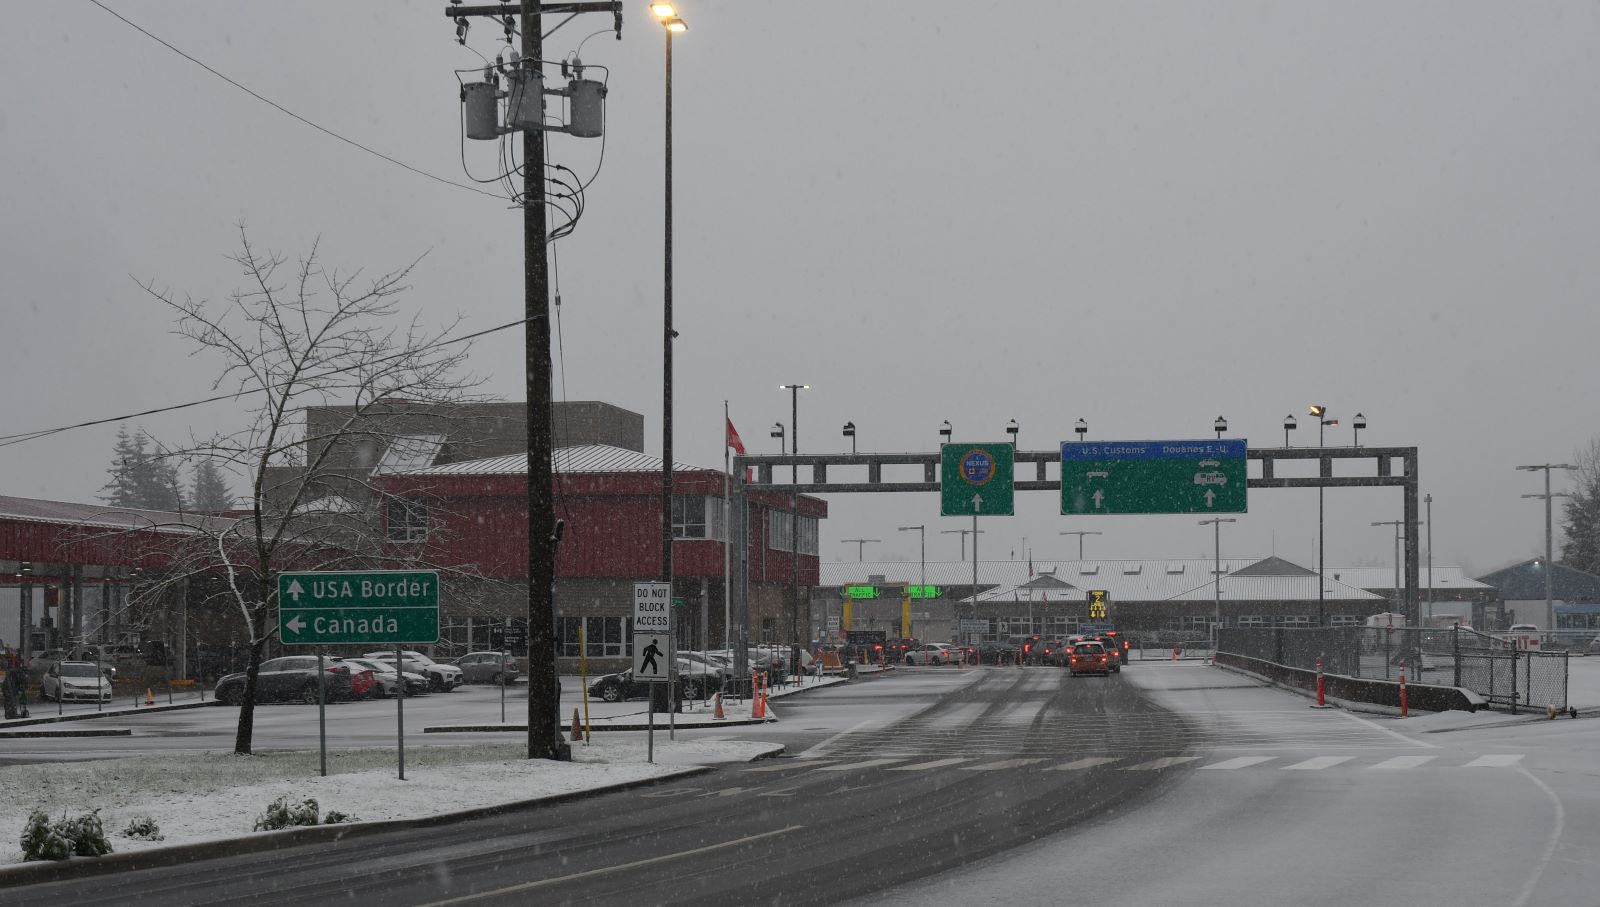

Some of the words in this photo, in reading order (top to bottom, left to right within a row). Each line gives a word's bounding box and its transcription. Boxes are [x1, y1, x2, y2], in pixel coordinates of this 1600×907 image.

[1082, 447, 1100, 455] U.S.
[1104, 446, 1146, 454] Customs
[1163, 446, 1204, 454] Douanes
[1206, 474, 1216, 482] RV
[313, 581, 353, 599] USA
[361, 579, 430, 598] Border
[637, 589, 648, 598] DO
[652, 589, 667, 598] NOT
[639, 602, 665, 612] BLOCK
[314, 615, 398, 634] Canada
[636, 616, 668, 626] ACCESS
